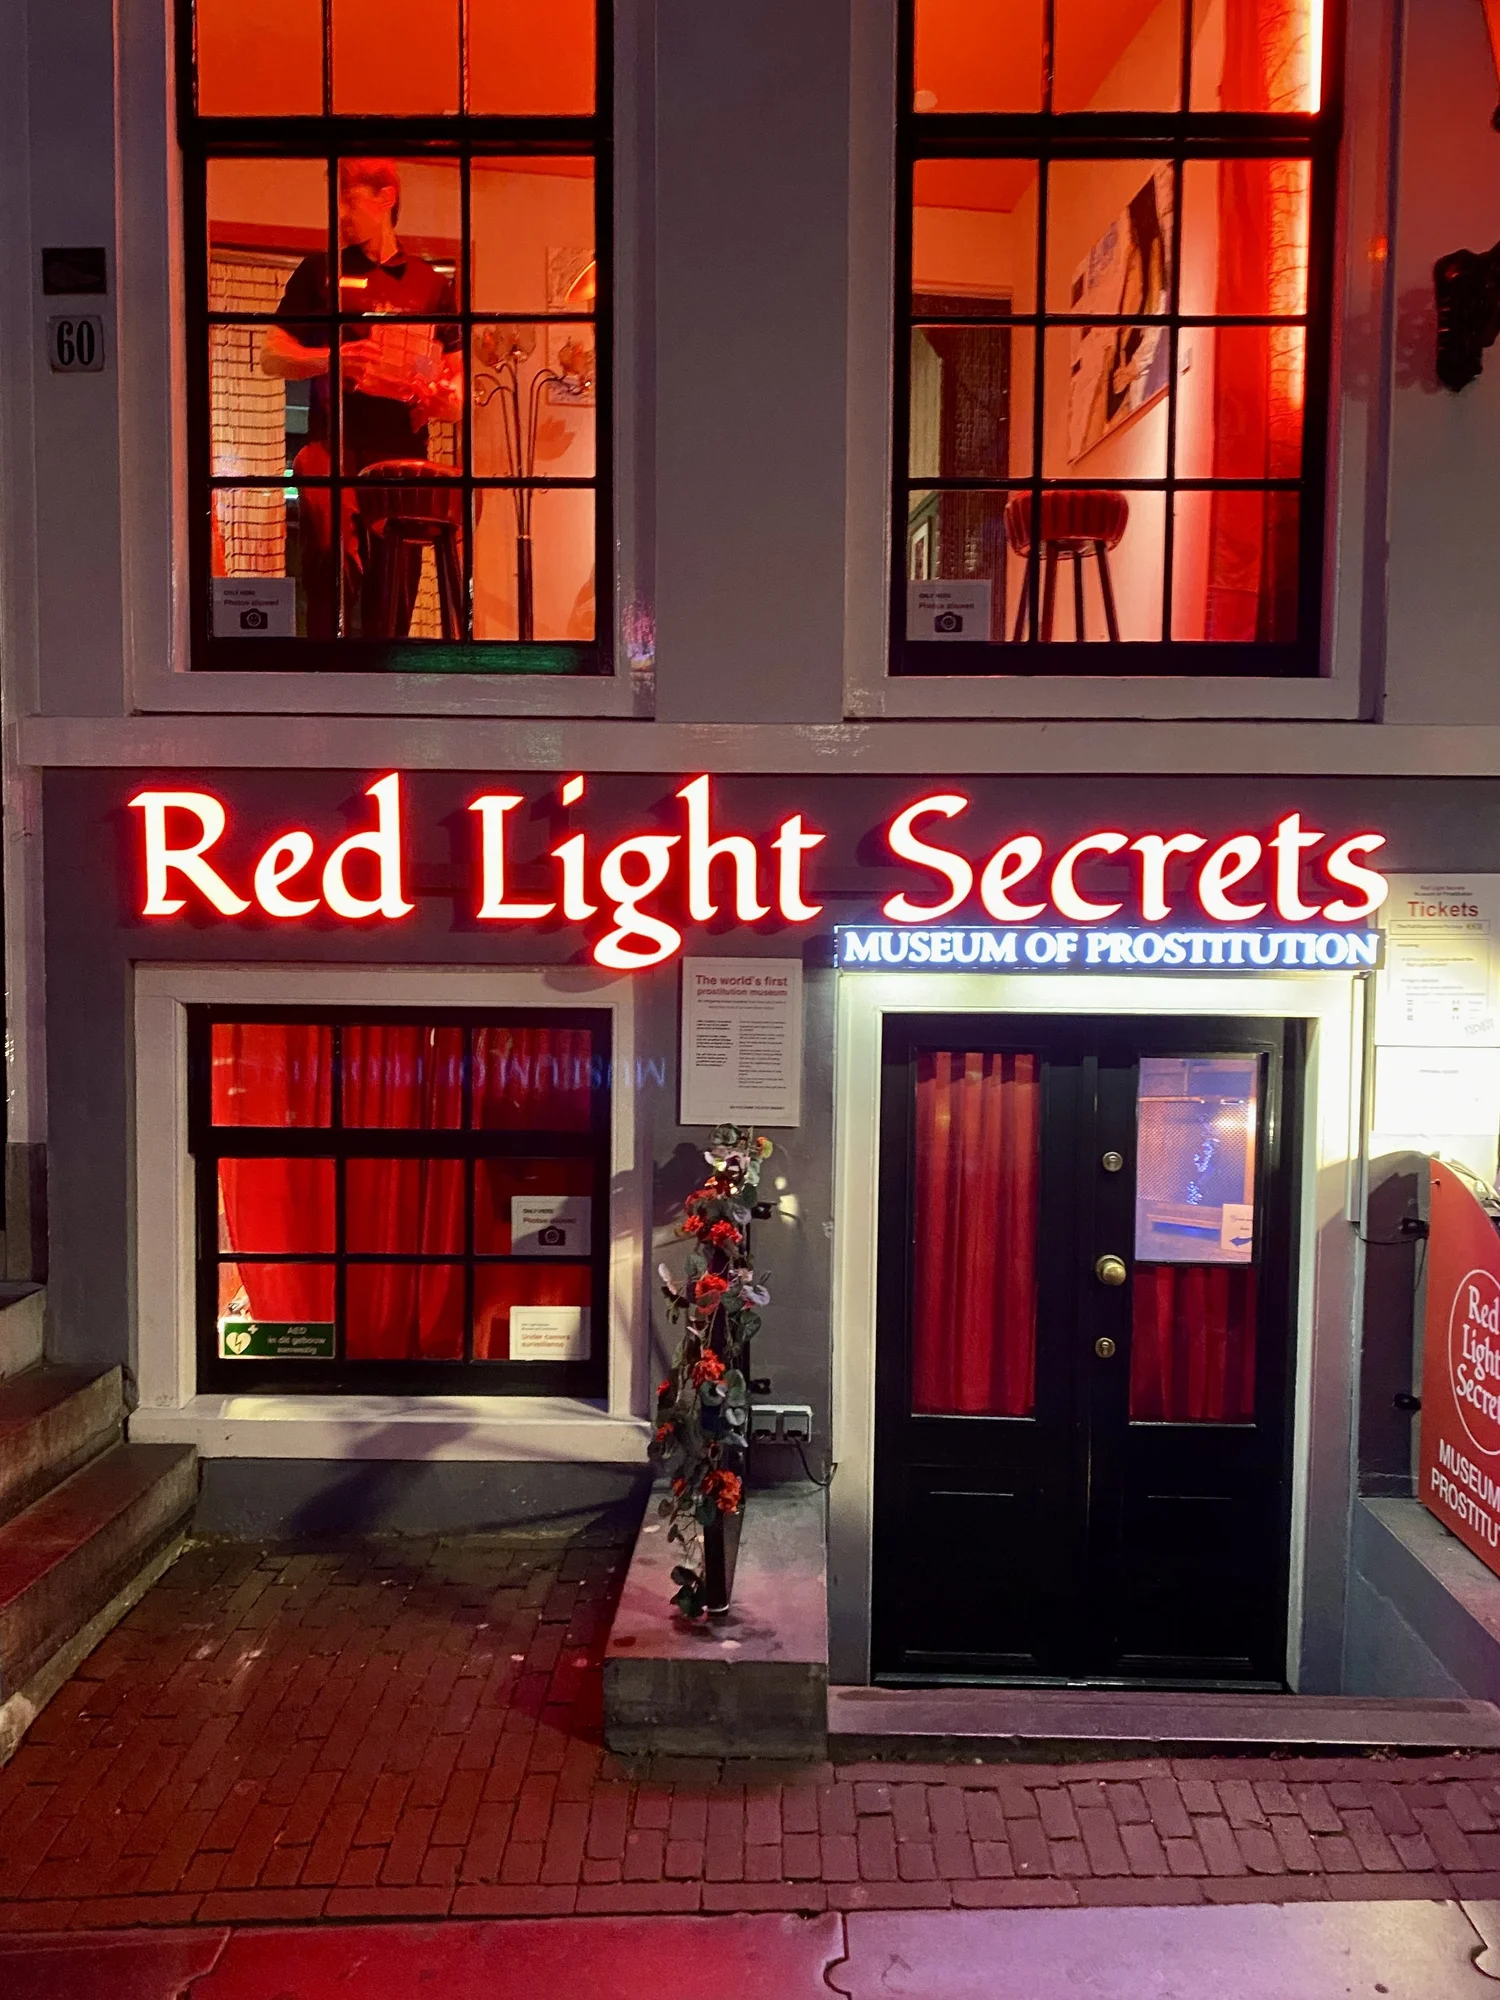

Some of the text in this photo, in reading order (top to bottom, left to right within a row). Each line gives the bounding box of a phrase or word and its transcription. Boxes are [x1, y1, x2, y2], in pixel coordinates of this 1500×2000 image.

[57, 321, 95, 366] 60
[127, 772, 1390, 970] Red Light Secrets
[1407, 901, 1479, 917] Tickets
[843, 931, 1379, 967] MUSEUM OF PROSTITUTION
[695, 975, 789, 987] The world's first
[697, 987, 788, 997] prostitution museum
[1468, 1284, 1500, 1336] Red
[287, 1326, 308, 1335] AED
[1439, 1438, 1500, 1513] MUSEUM
[1431, 1467, 1500, 1548] PROSTITU
